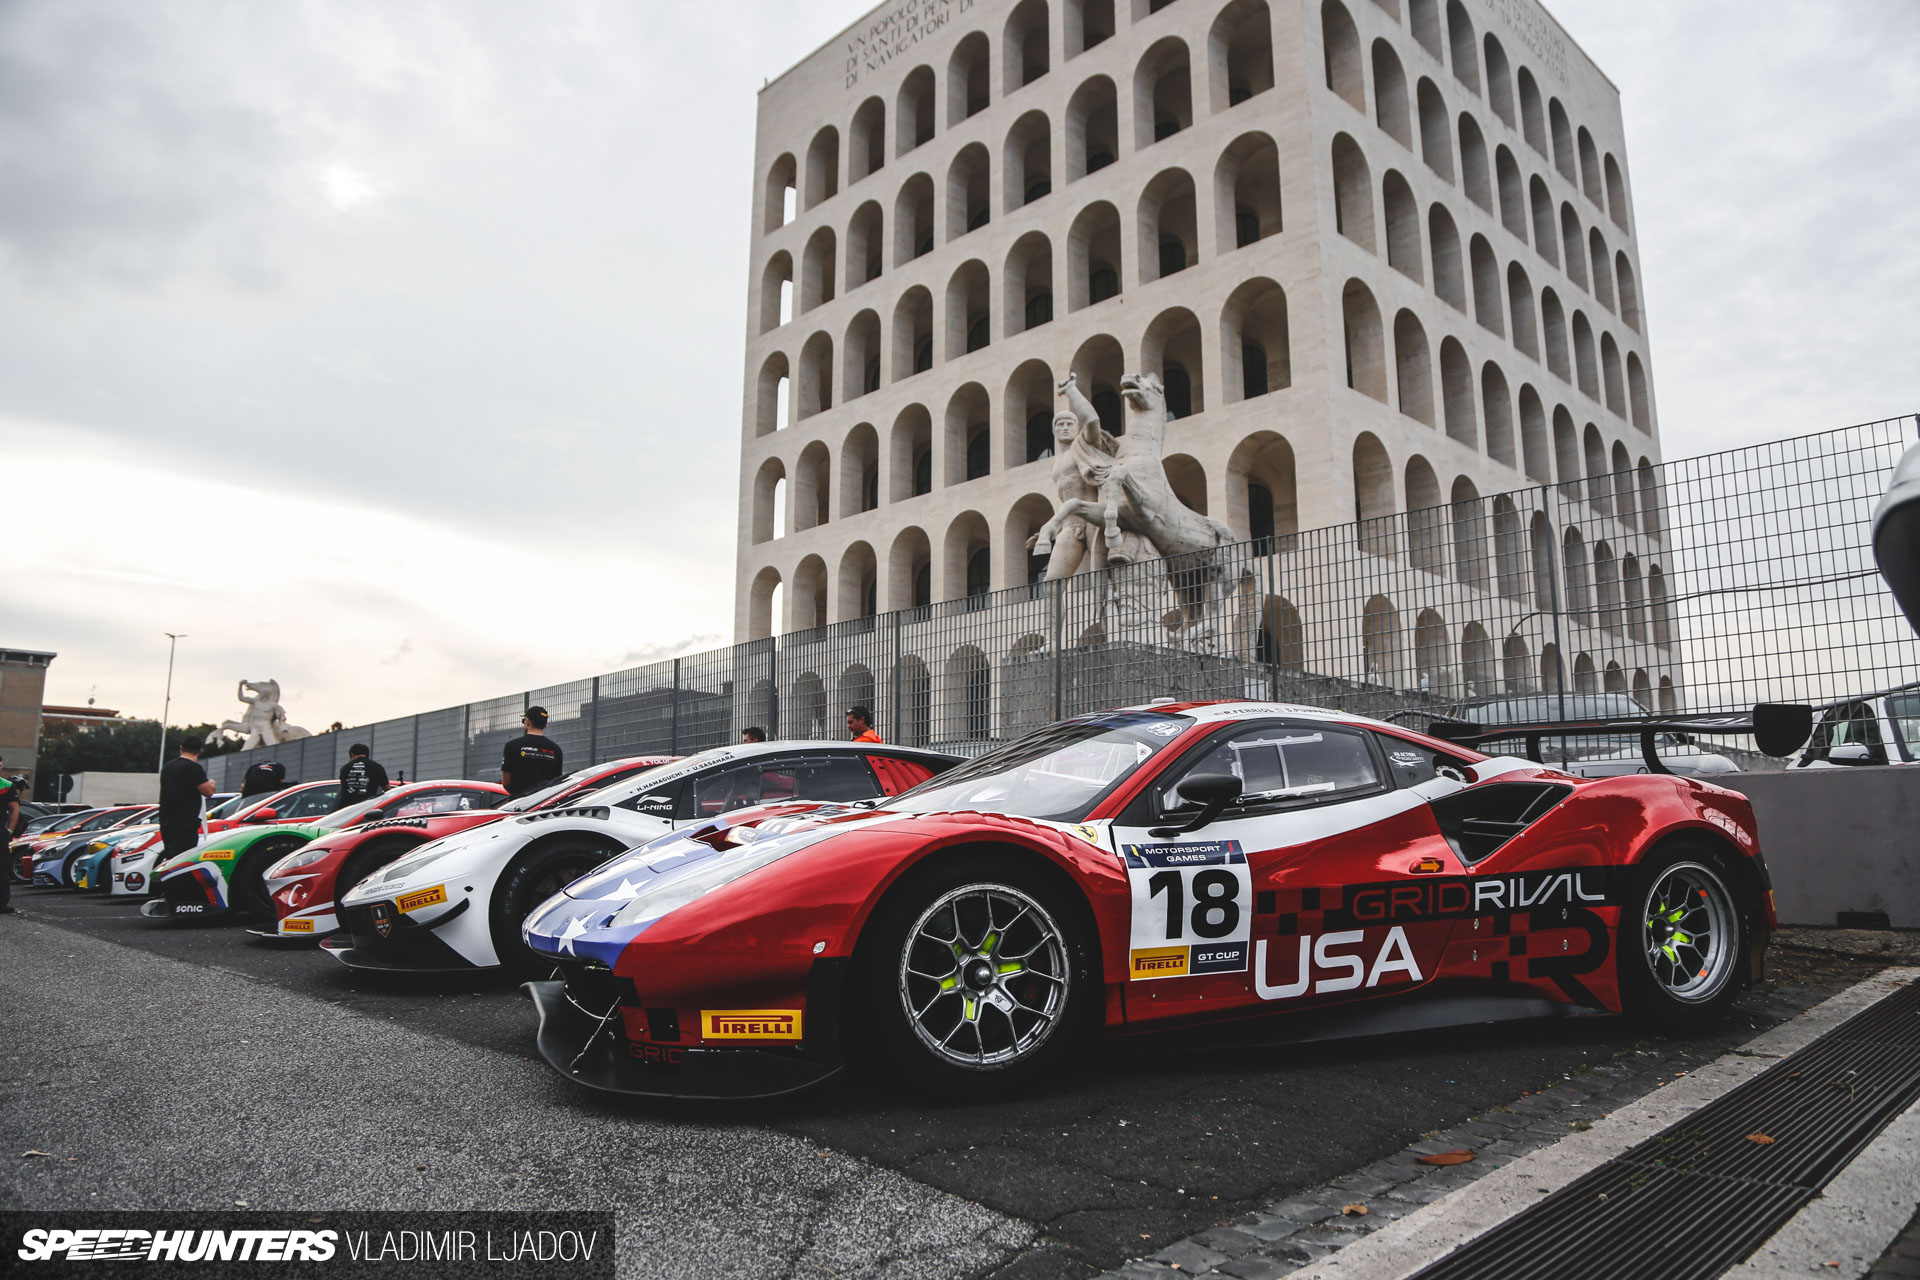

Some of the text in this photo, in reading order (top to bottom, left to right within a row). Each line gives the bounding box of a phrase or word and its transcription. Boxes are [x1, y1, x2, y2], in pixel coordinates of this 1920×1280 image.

[863, 25, 901, 60] SANTI
[906, 13, 919, 33] DI
[846, 70, 858, 89] DI
[866, 8, 950, 76] NAVIGATORI
[1145, 844, 1221, 856] MOTORSPORT
[1166, 854, 1207, 863] GAMES
[399, 889, 441, 910] PIRELLI
[1148, 869, 1240, 940] 18
[1134, 954, 1185, 971] PIRELLI
[1198, 950, 1240, 961] GT CUP
[1255, 926, 1424, 1000] USA
[711, 1015, 793, 1034] PIRELLI
